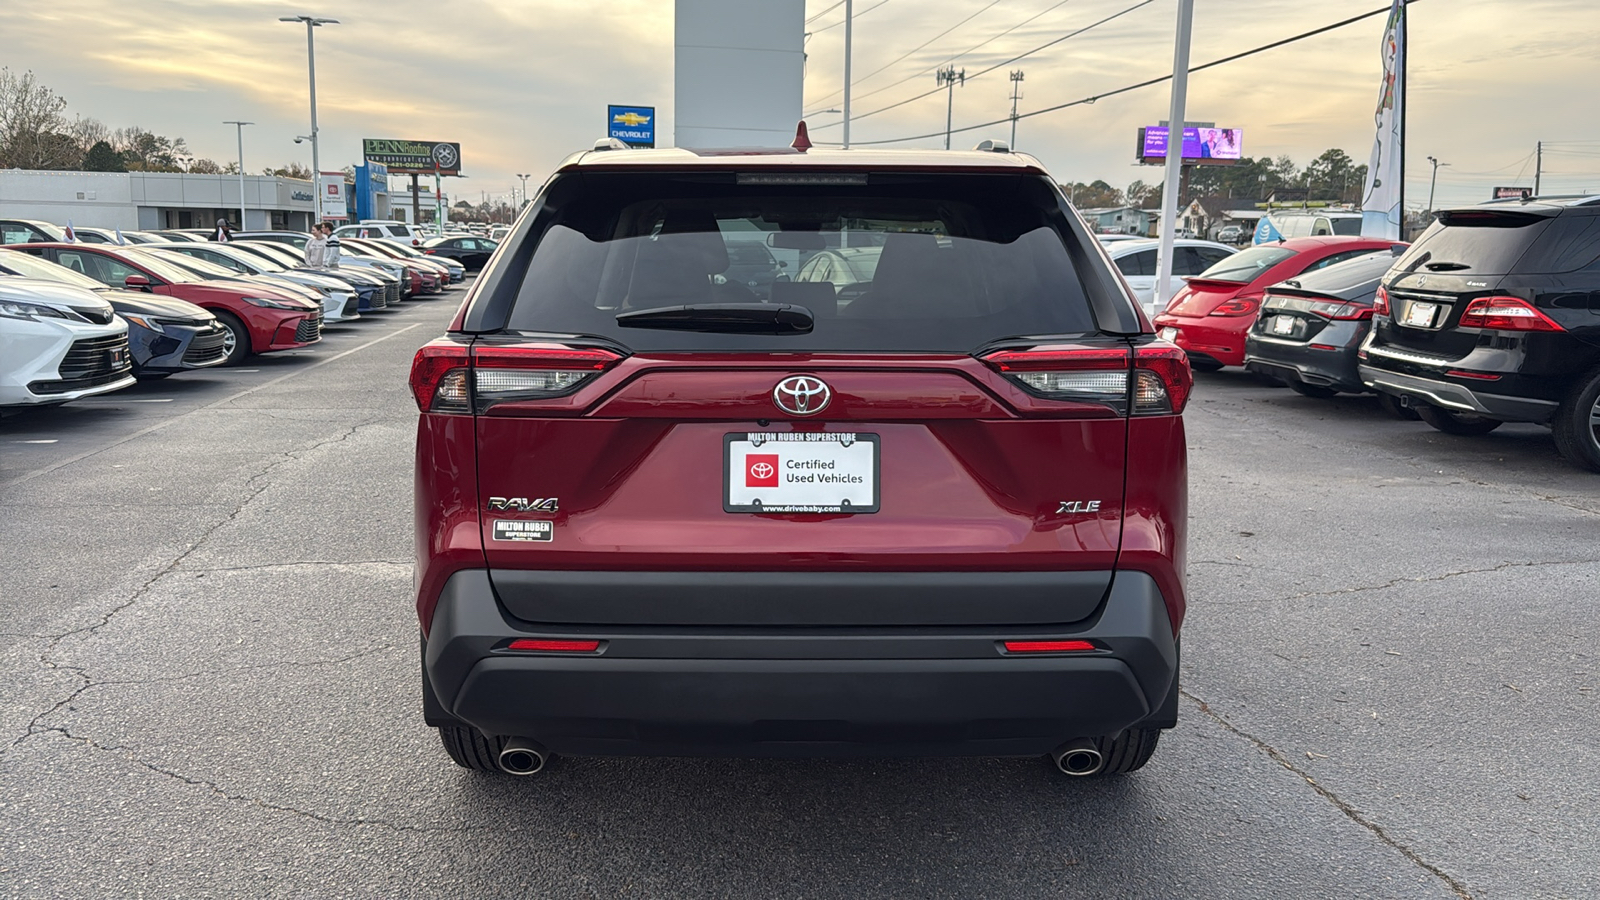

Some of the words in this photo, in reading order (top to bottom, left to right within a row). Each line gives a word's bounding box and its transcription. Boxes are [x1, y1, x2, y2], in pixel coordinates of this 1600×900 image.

[365, 140, 407, 152] PENN
[404, 143, 431, 156] Roofing
[748, 433, 776, 441] MILTON
[778, 433, 804, 441] RUBEN
[805, 433, 856, 441] SUPERSTORE
[786, 460, 835, 469] Certified
[786, 473, 814, 483] Used
[817, 473, 863, 483] Vehicles
[487, 496, 559, 513] RAV4
[1056, 500, 1101, 514] XLE
[496, 522, 523, 531] MILTON
[524, 522, 550, 531] RUBEN
